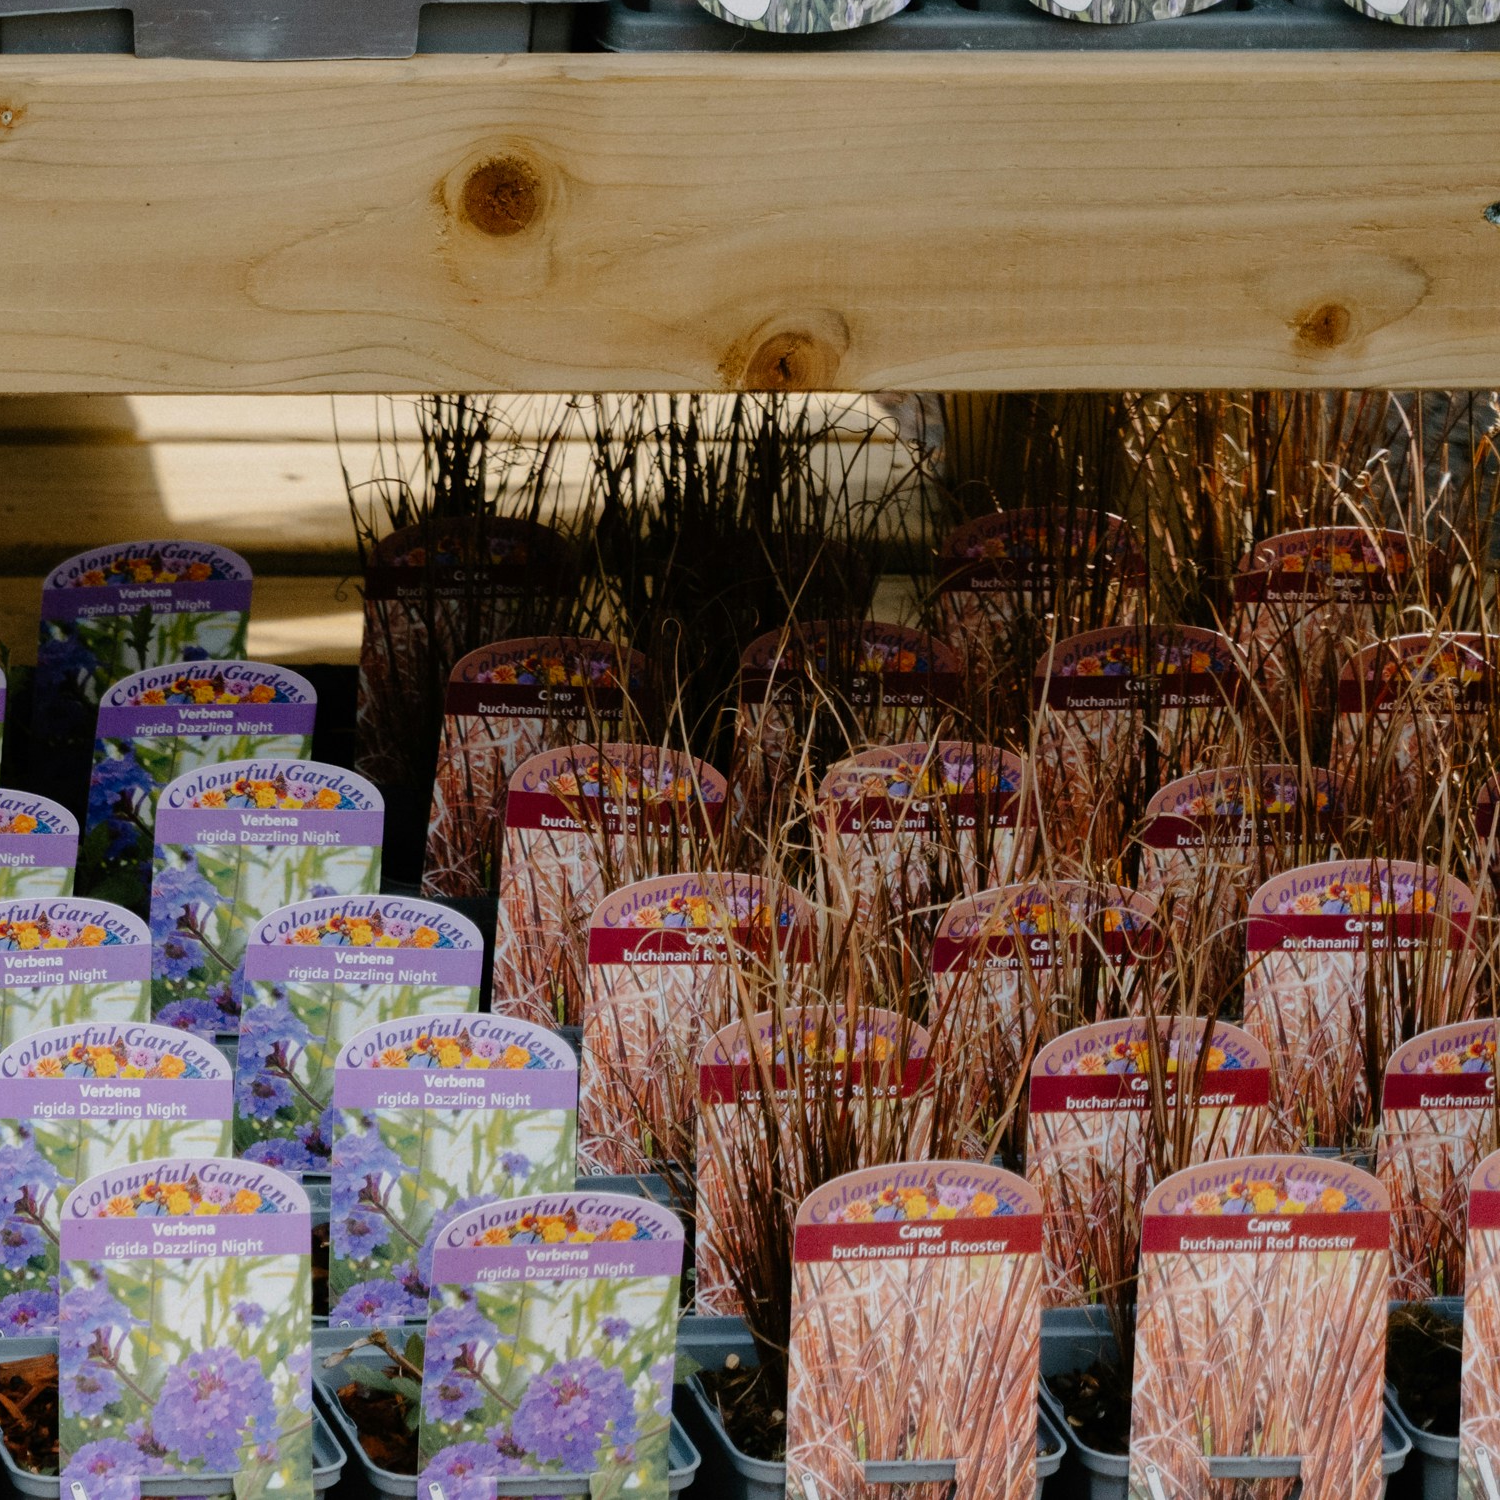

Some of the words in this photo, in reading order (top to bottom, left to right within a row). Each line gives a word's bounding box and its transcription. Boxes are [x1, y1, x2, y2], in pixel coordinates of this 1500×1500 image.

[1247, 1219, 1291, 1233] Carex
[1179, 1238, 1261, 1252] buchananii
[1266, 1237, 1293, 1250] Red
[1298, 1236, 1356, 1250] Rooster
